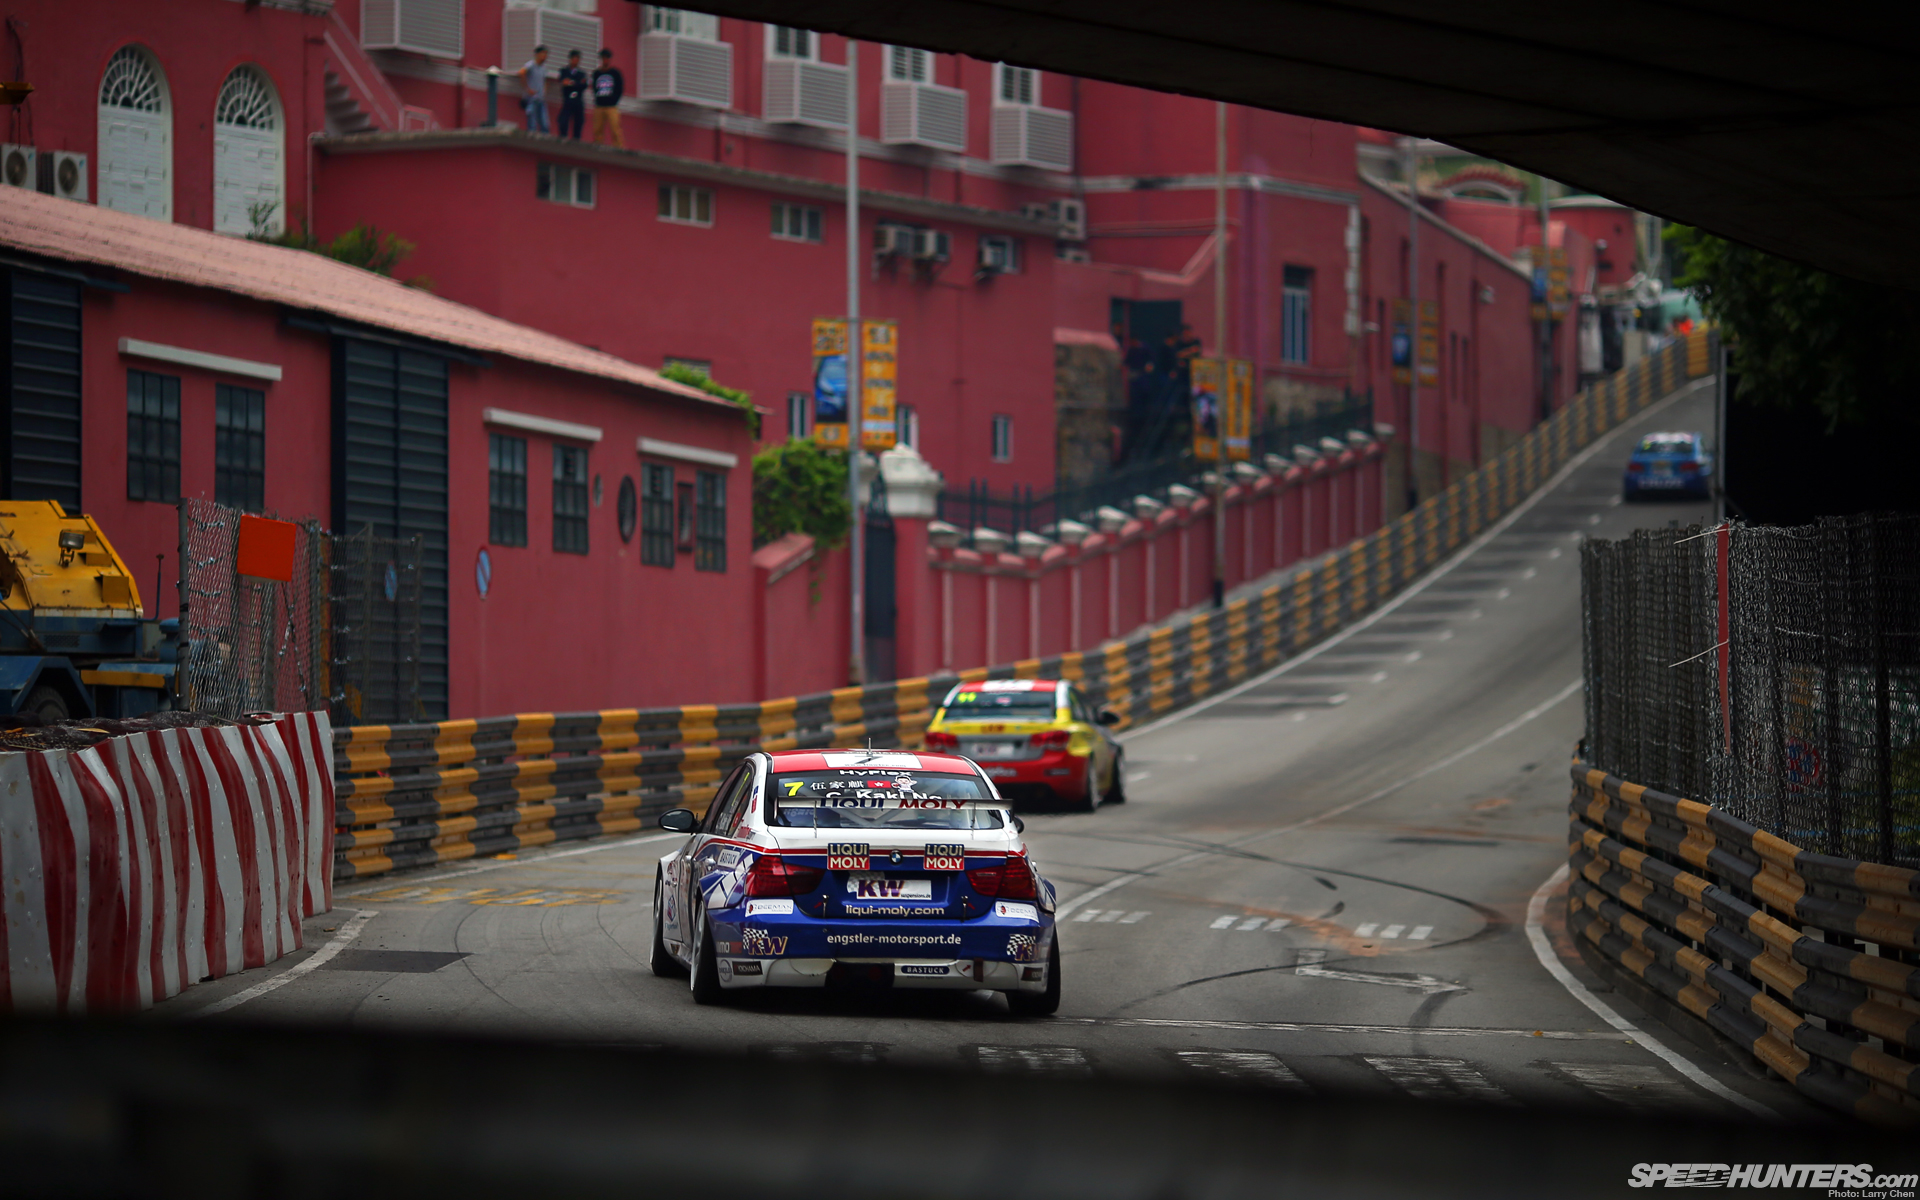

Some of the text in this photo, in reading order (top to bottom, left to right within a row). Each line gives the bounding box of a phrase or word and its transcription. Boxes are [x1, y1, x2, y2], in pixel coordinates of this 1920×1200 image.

[784, 781, 804, 797] 7
[820, 798, 968, 809] LIQUI MOLY
[829, 843, 868, 856] LIQUI
[926, 844, 963, 857] LIQUI
[829, 857, 869, 869] MOLY
[925, 857, 963, 869] MOLY
[857, 879, 905, 898] KW
[845, 905, 945, 917] liqui-moly.com
[748, 936, 788, 955] KW
[827, 933, 961, 946] engstler-motorsport.de
[906, 966, 944, 974] BASTUCK
